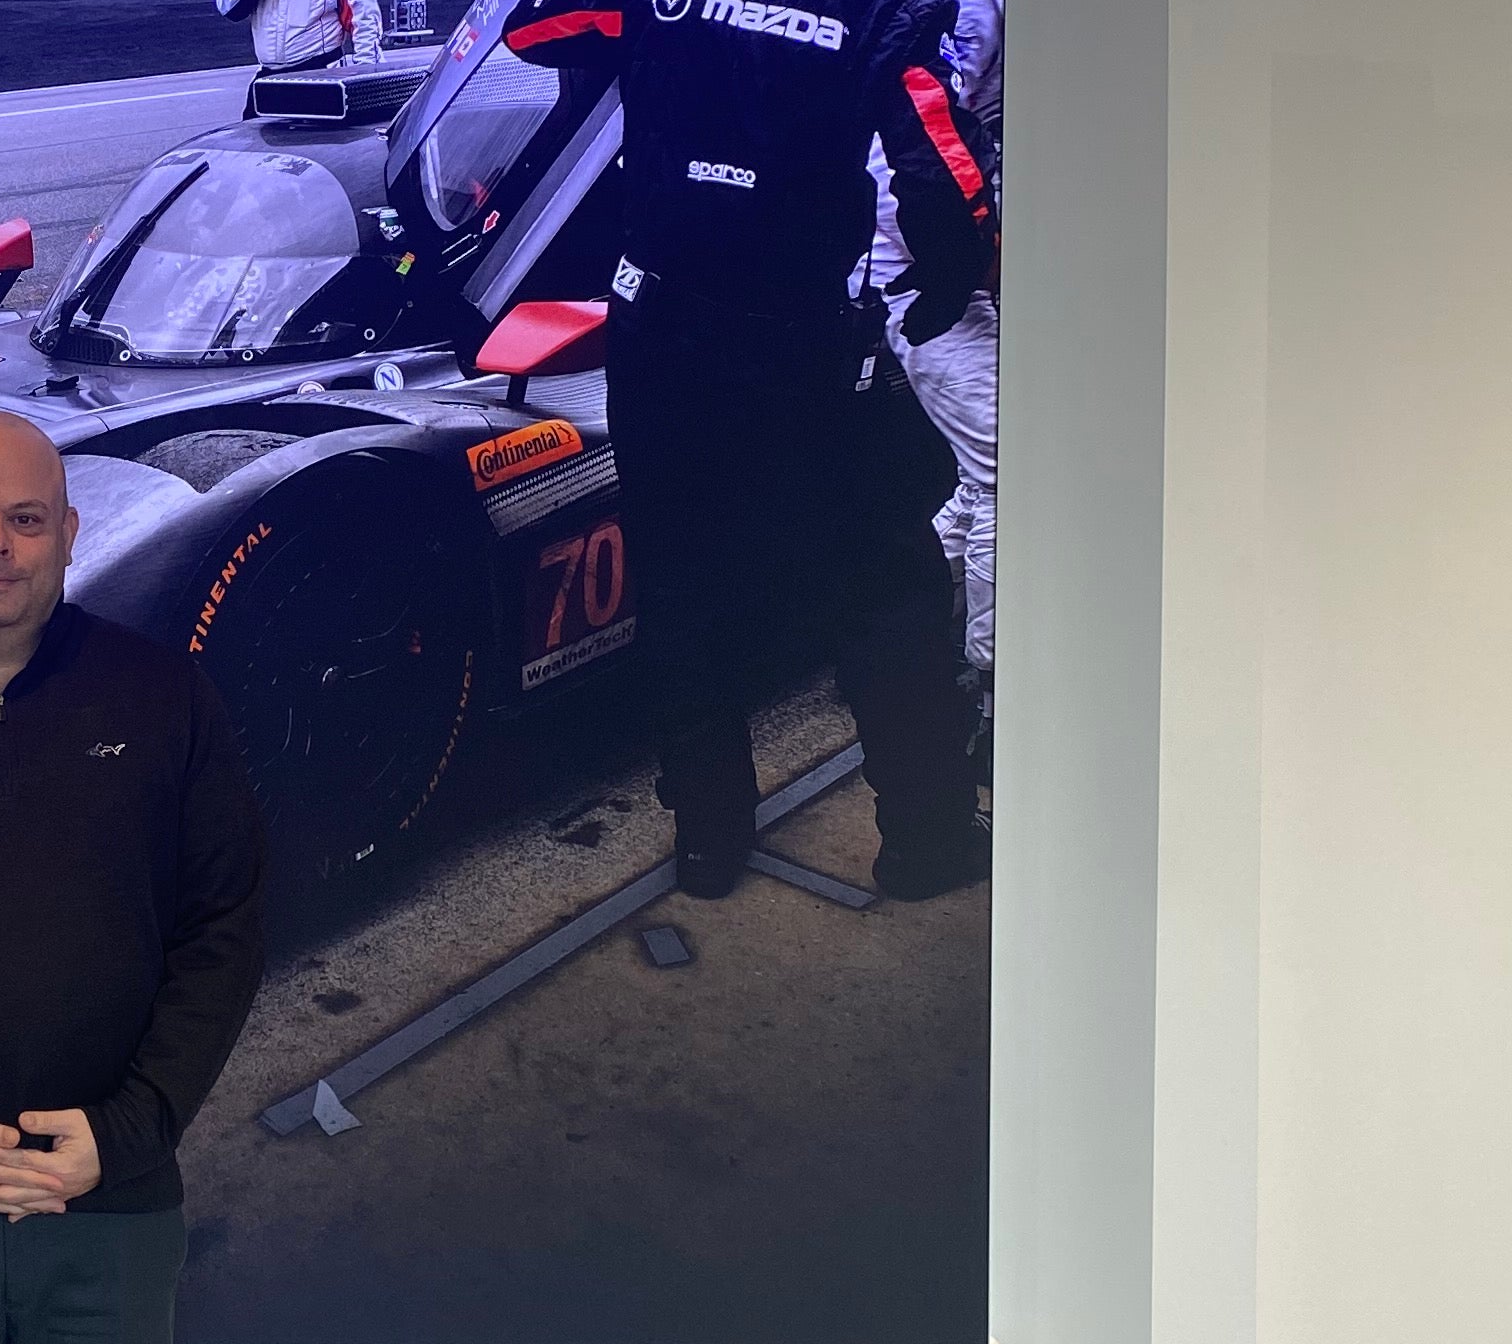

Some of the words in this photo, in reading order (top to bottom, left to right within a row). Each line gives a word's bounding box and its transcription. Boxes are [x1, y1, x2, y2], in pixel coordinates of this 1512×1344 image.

[687, 160, 757, 189] sparco
[475, 423, 563, 483] Continental
[189, 522, 273, 653] TINENTAL
[539, 523, 624, 649] 70
[525, 622, 635, 684] WeatherTech
